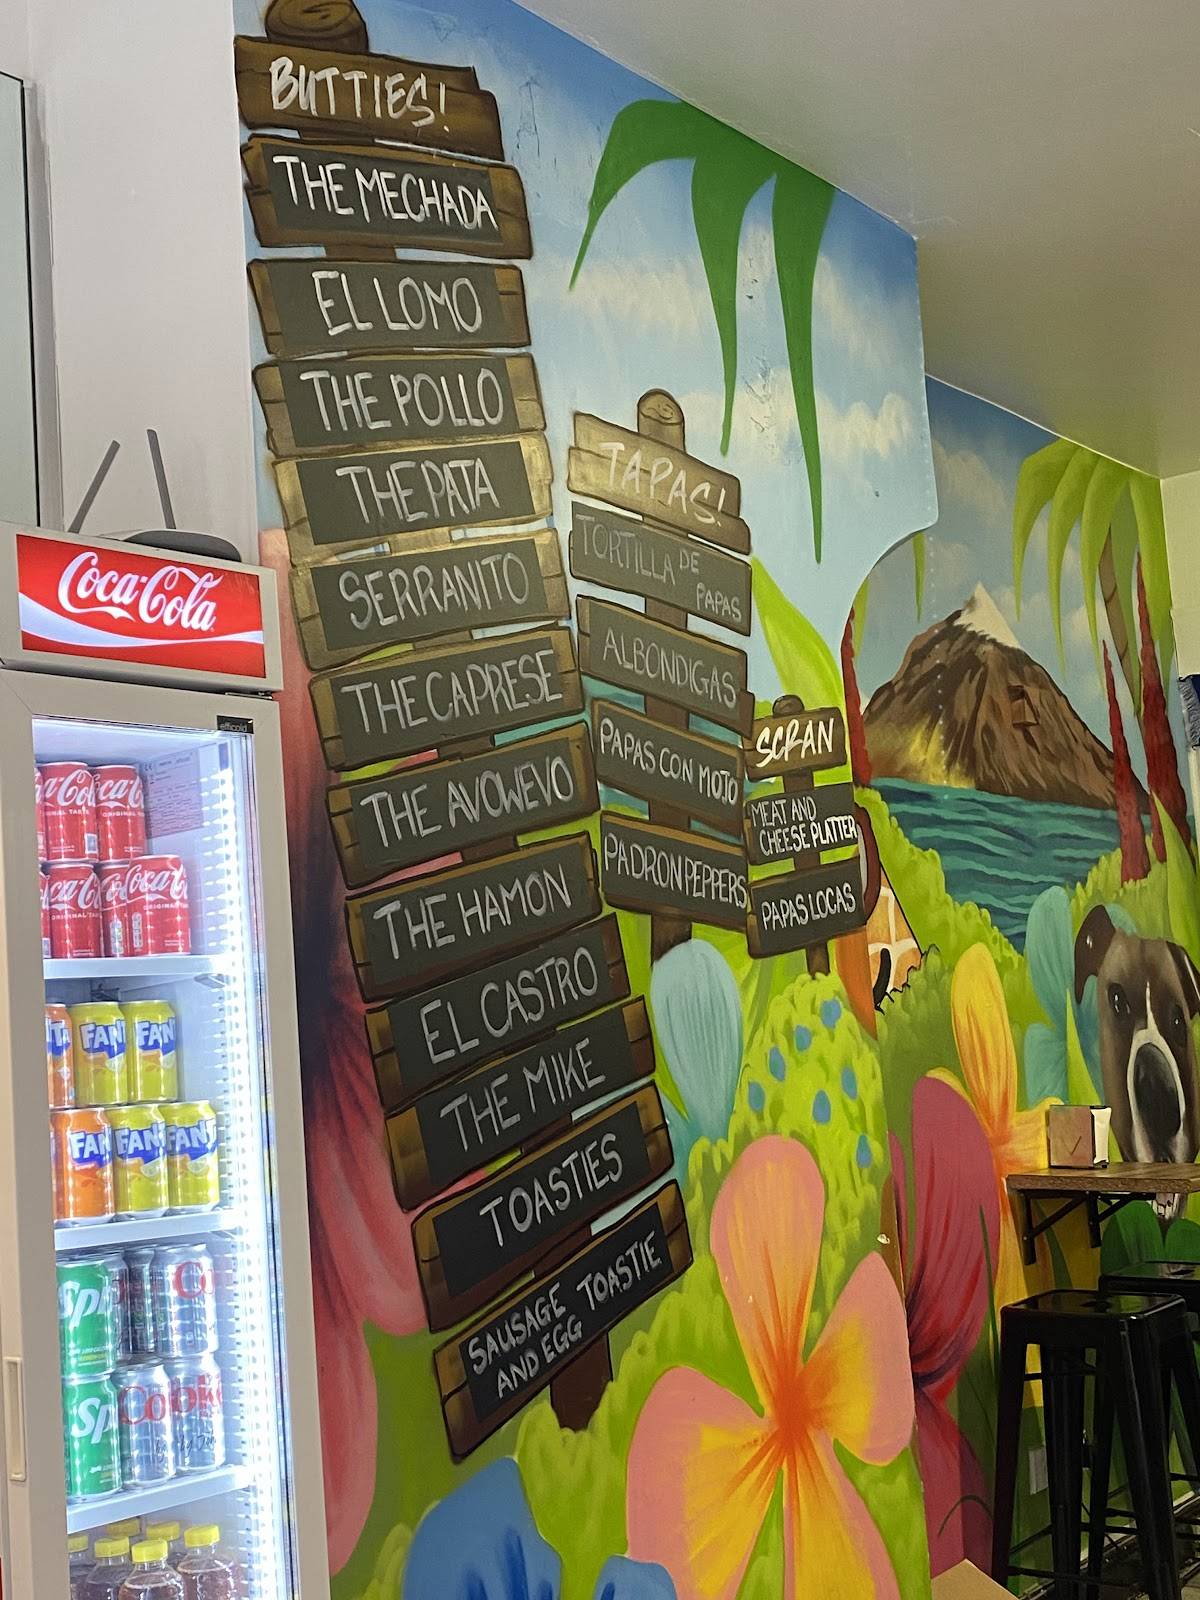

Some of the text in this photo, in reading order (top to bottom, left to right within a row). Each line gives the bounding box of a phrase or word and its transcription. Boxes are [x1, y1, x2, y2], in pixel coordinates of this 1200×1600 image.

[269, 57, 450, 133] BUTTIES!
[273, 156, 499, 231] THE MECHADA
[312, 270, 482, 336] EL LOMO
[300, 367, 503, 432] THE POLLO
[336, 457, 501, 524] THE PATA
[600, 441, 726, 528] TAPAS!
[576, 513, 700, 586] TORTILLA DE
[58, 551, 224, 631] Coca-Cola
[338, 552, 530, 630] SERRANITO
[696, 582, 742, 622] PAPAS
[340, 650, 563, 734] THE CAPRESE
[603, 627, 737, 709] ALBONDIGAS
[600, 717, 739, 805] PAPAS CON MOJO
[756, 717, 834, 768] SCRAN
[360, 755, 574, 847] THE AVOWEVO
[750, 796, 817, 827] MEAT AND
[760, 815, 858, 856] CHEESE PLATTER
[604, 832, 748, 909] PADRON PEPPERS
[761, 882, 857, 931] PAPAS LOCAS
[373, 864, 572, 960] THE HAMON
[420, 947, 598, 1065] EL CASTRO
[440, 1037, 606, 1152] THE MIKE
[479, 1132, 623, 1248] TOASTIES
[468, 1230, 663, 1376] SAUSAGE TOASTIE
[496, 1313, 583, 1400] AND EGG
